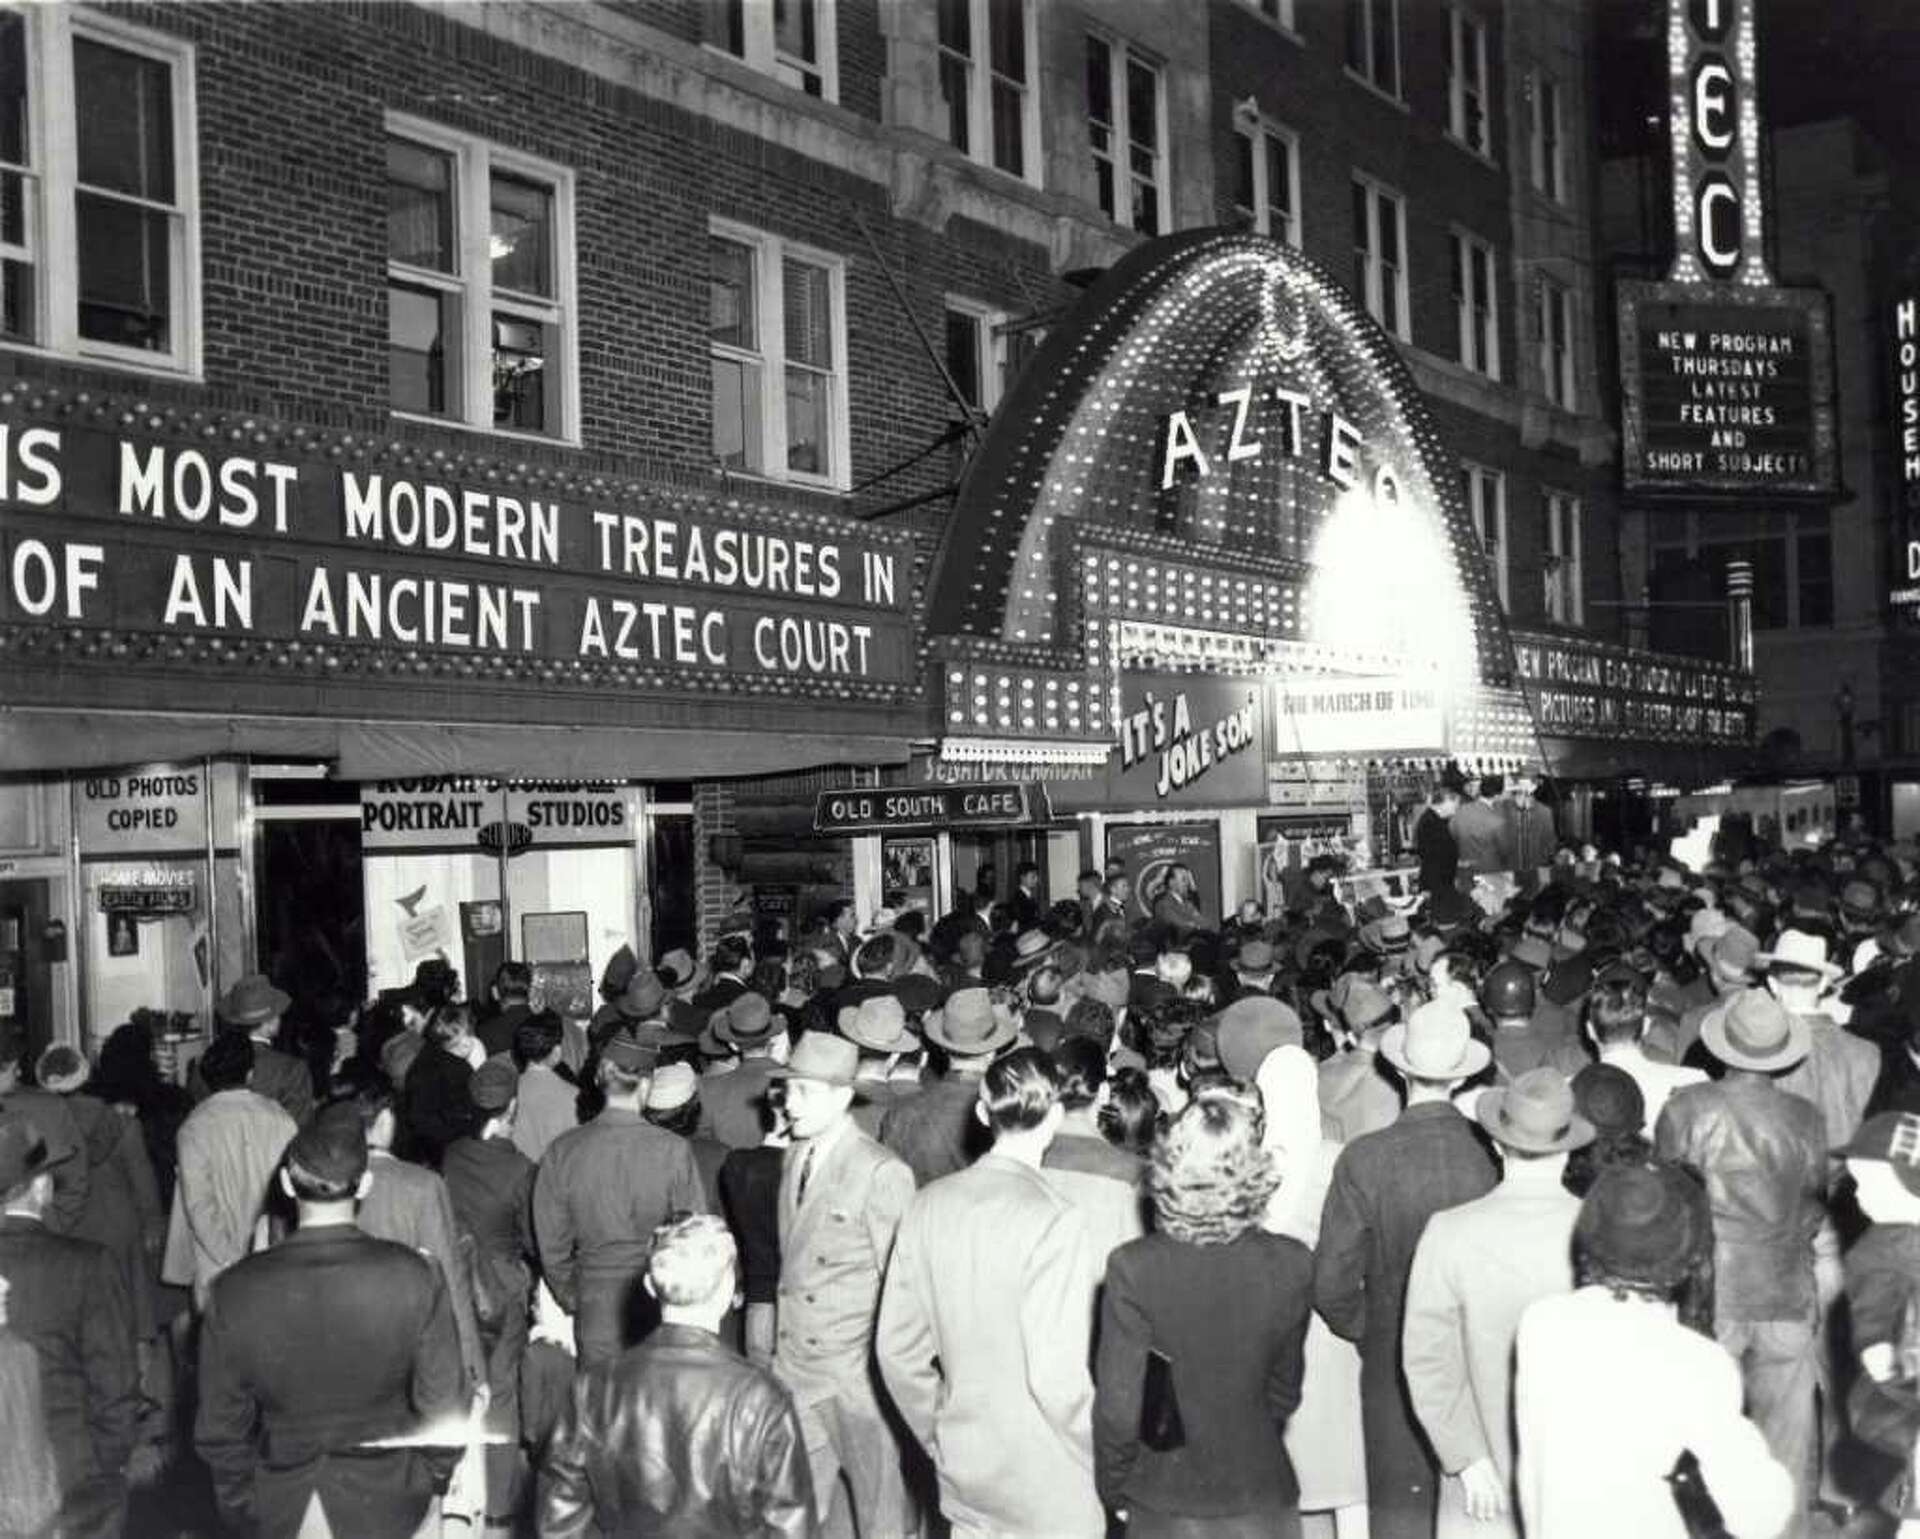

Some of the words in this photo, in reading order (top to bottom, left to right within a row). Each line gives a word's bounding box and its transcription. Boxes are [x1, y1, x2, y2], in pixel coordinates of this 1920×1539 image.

[1658, 331, 1697, 350] NEW
[1709, 333, 1793, 352] PROGRAM
[1672, 355, 1779, 377] THURSDAYS
[1692, 381, 1761, 399] LATEST
[1680, 404, 1775, 425] FEATURES
[1711, 430, 1746, 447] AND
[1647, 452, 1704, 472] SHORT
[119, 440, 298, 533] MOST
[342, 471, 559, 564] MODERN
[593, 510, 842, 599] TREASURES
[862, 551, 895, 605] IN
[13, 538, 105, 619] OF
[164, 553, 254, 631] AN
[301, 566, 541, 652] ANCIENT
[579, 597, 726, 666] AZTEC
[754, 616, 872, 676] COURT
[1172, 693, 1192, 744] A
[1156, 728, 1212, 797] JOKE
[86, 778, 121, 799] OLD
[127, 774, 199, 798] PHOTOS
[107, 806, 178, 831] COPIED
[361, 801, 483, 832] PORTRAIT
[527, 801, 624, 828] STUDIOS
[831, 800, 872, 820] OLD
[885, 796, 945, 818] SOUTH
[962, 793, 1014, 815] CAFE
